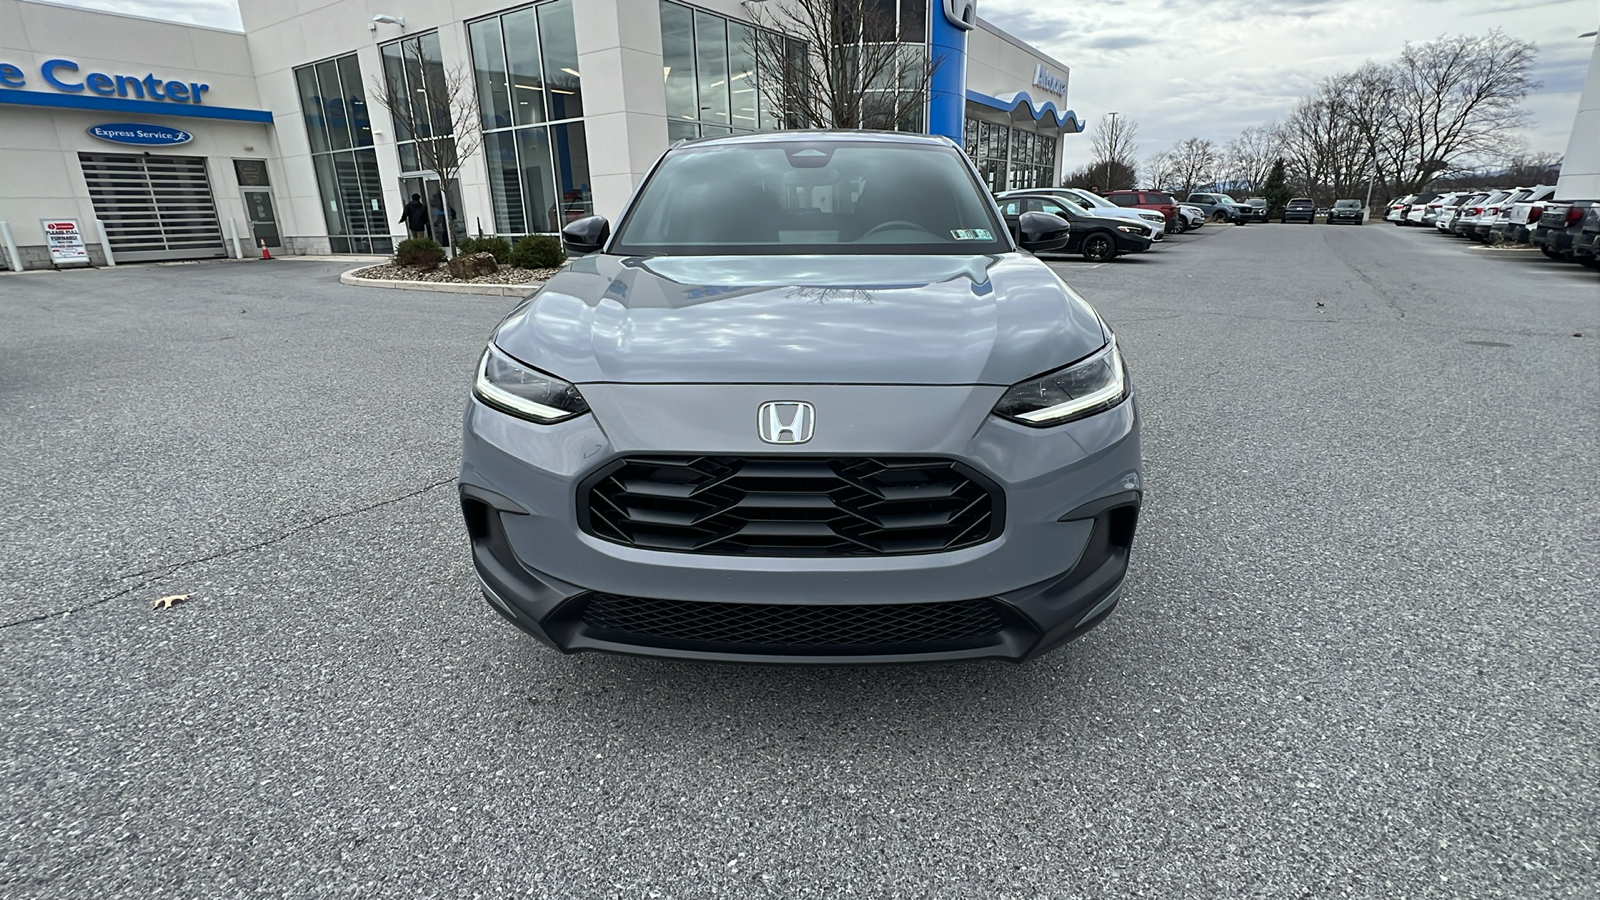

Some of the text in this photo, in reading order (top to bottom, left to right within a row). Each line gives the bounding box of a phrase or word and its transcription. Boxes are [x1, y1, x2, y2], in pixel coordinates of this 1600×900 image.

[41, 59, 210, 104] Center
[94, 127, 173, 139] Express Service
